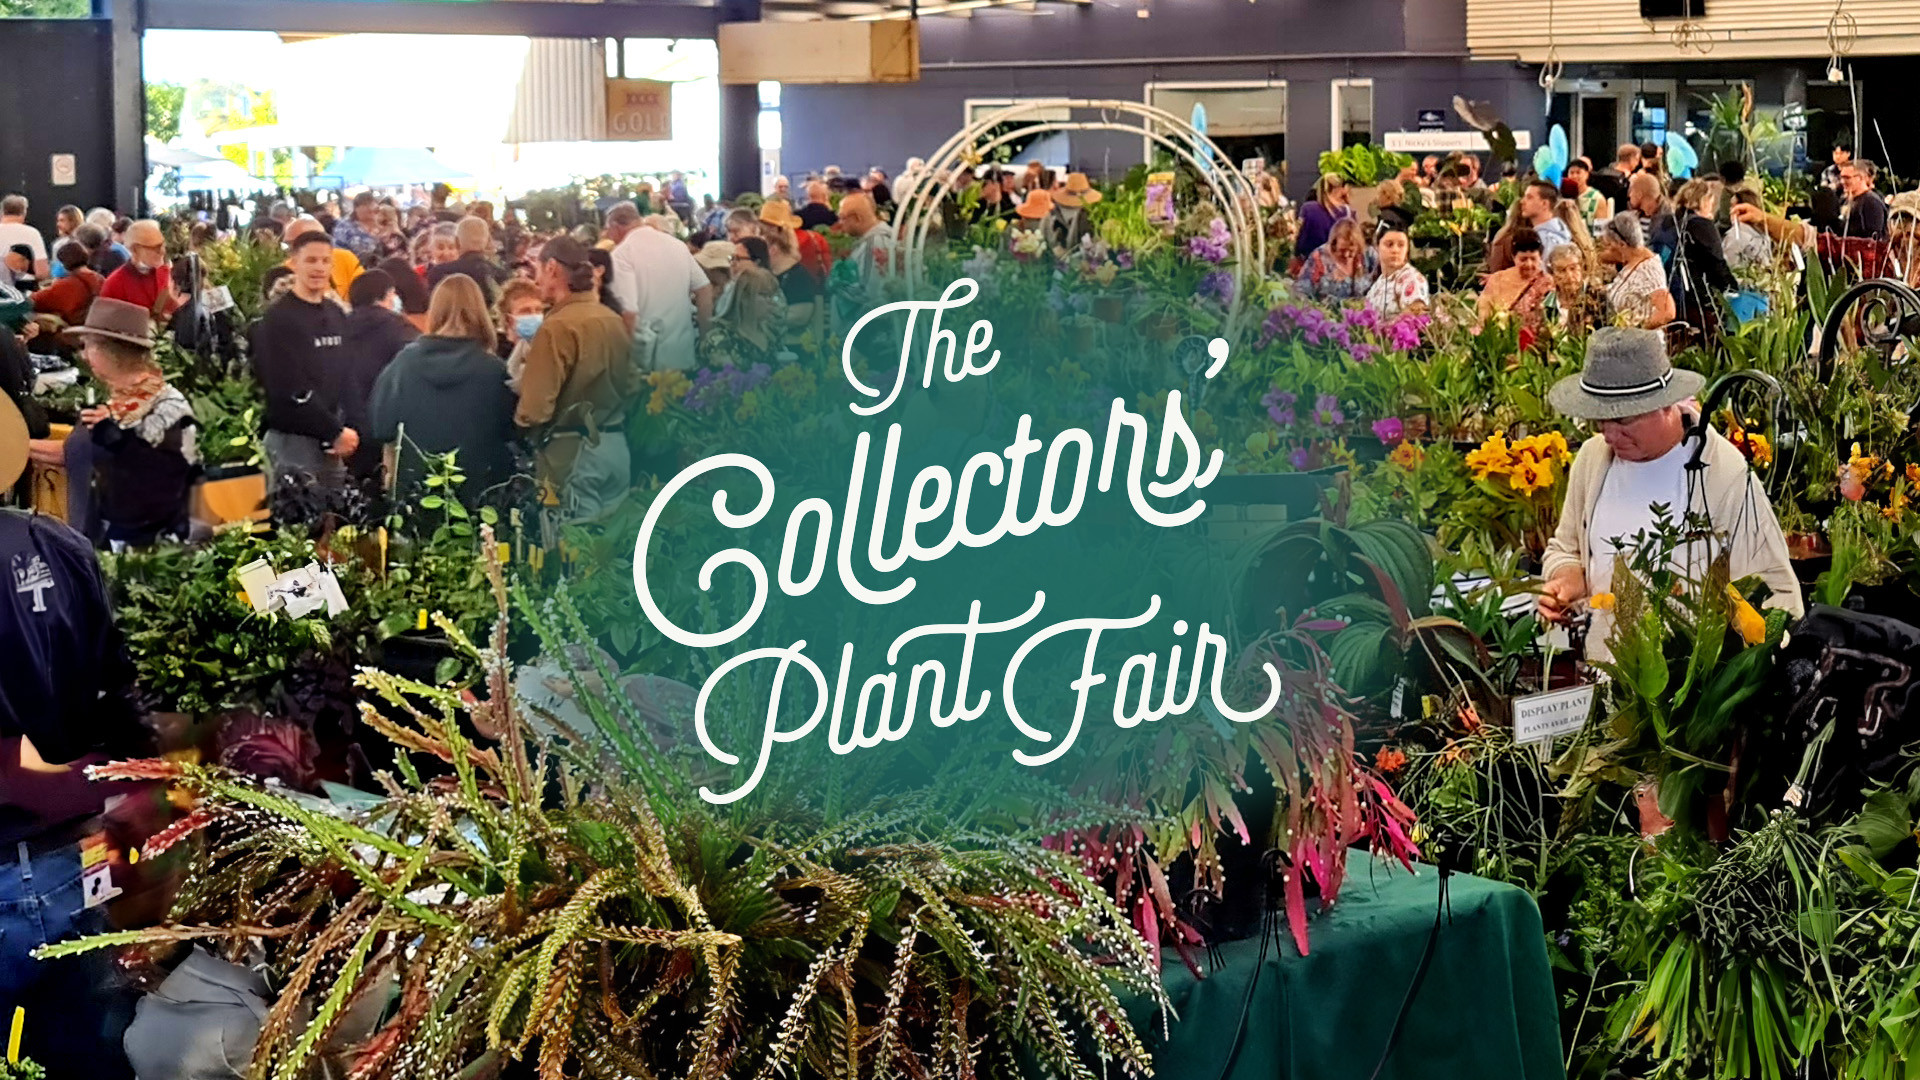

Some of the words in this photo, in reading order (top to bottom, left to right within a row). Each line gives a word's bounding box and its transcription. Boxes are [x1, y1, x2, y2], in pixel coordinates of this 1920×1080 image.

[1521, 703, 1558, 718] DISPLAY
[1560, 697, 1587, 711] PLANT
[1523, 721, 1549, 734] PLANTS
[1550, 714, 1585, 727] AVAILABLE
